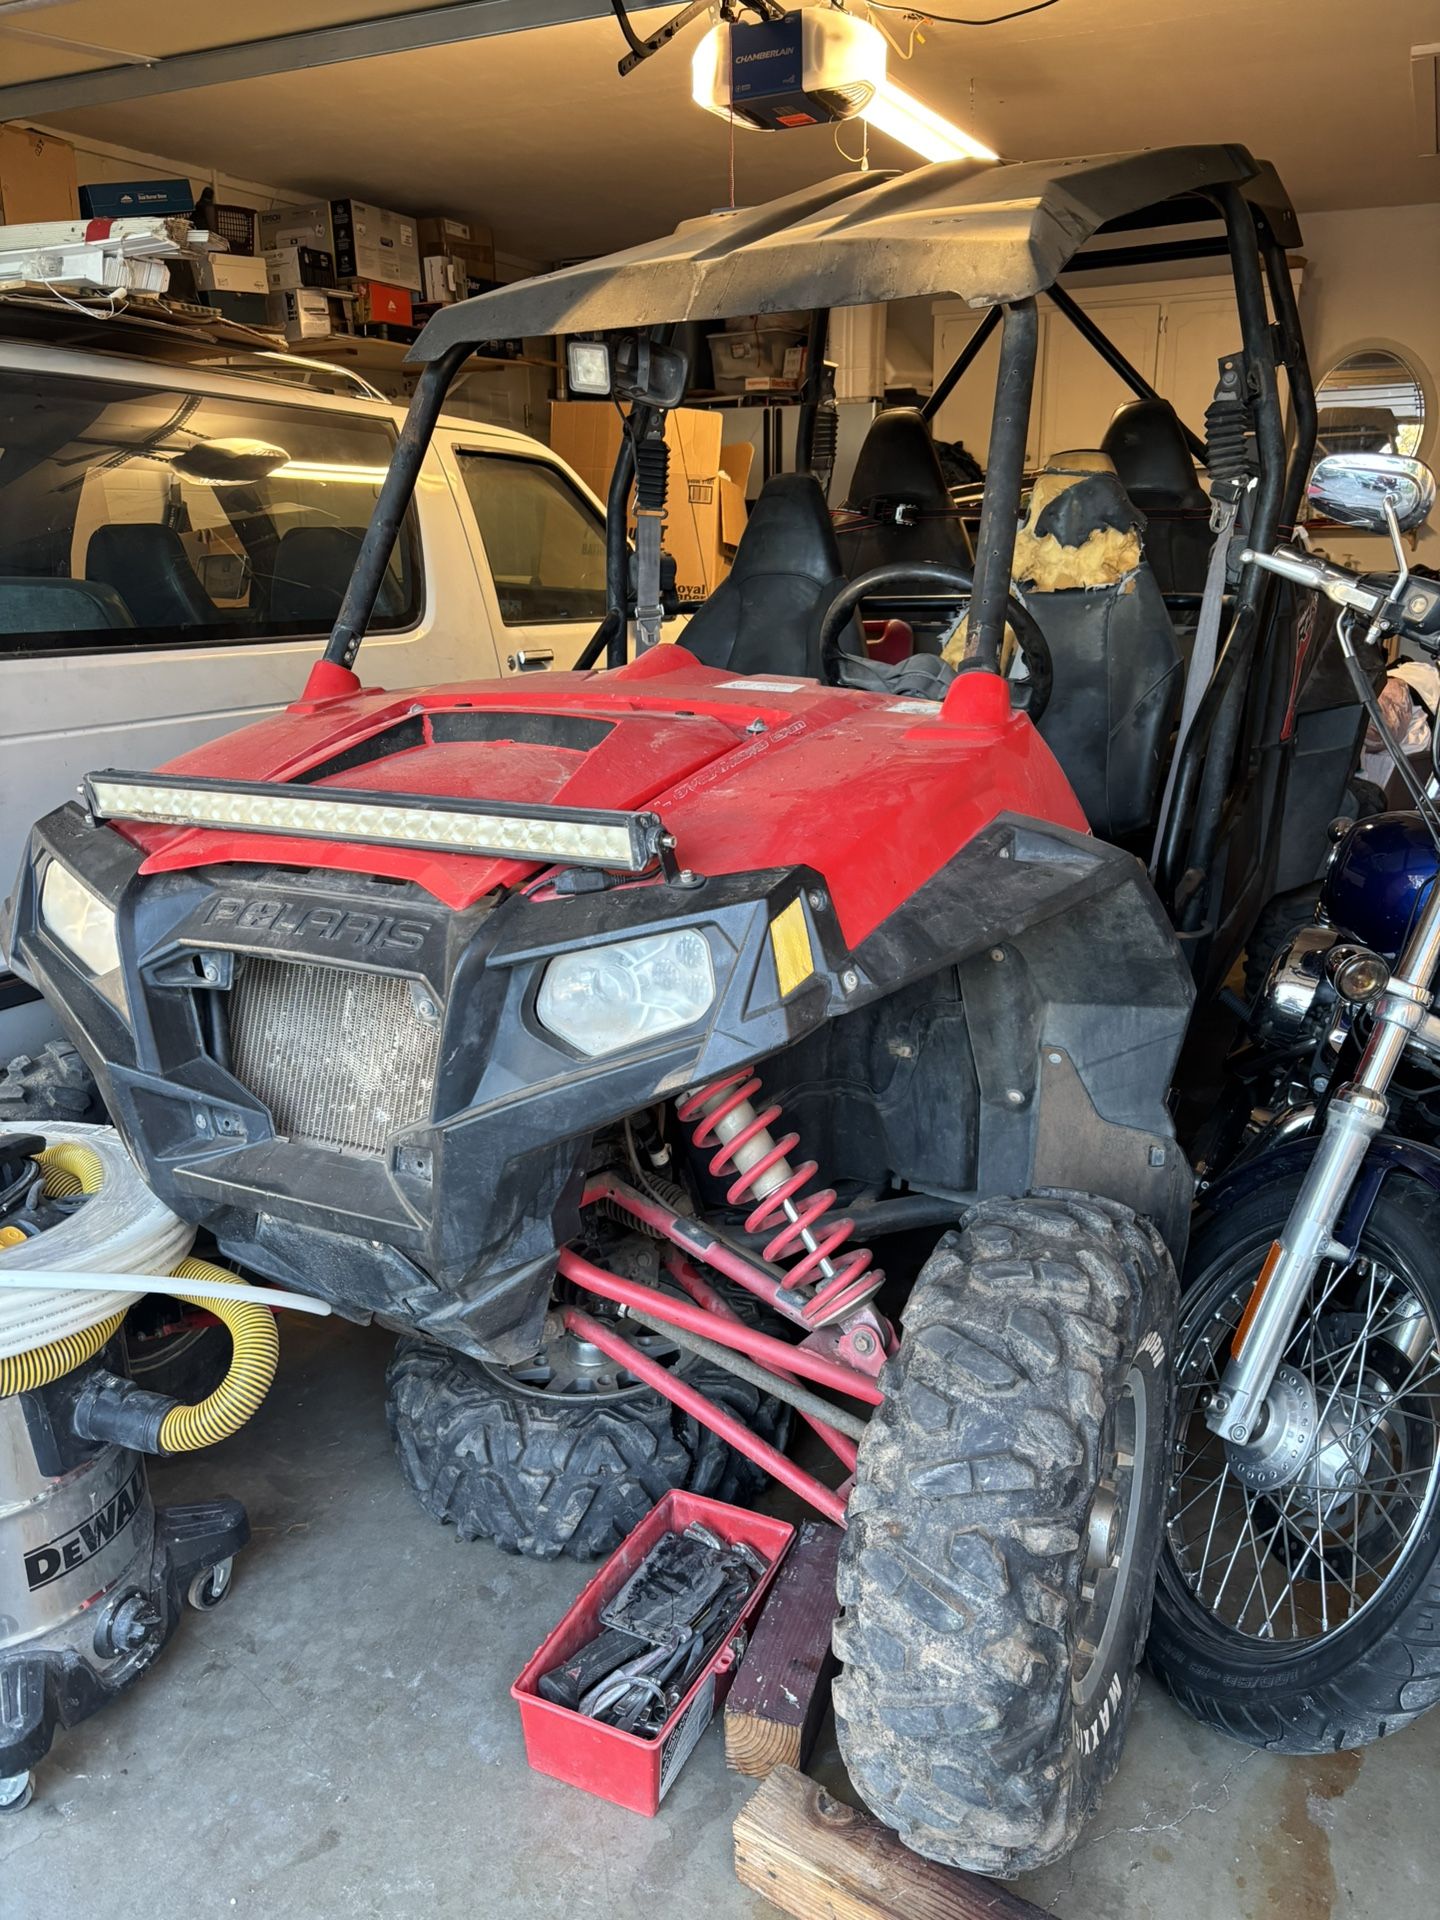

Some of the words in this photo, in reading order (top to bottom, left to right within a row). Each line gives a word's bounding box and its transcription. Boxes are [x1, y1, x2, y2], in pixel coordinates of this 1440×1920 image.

[735, 47, 795, 64] CHAMBERLAIN
[676, 584, 706, 597] oyal
[201, 897, 432, 953] POLARIS
